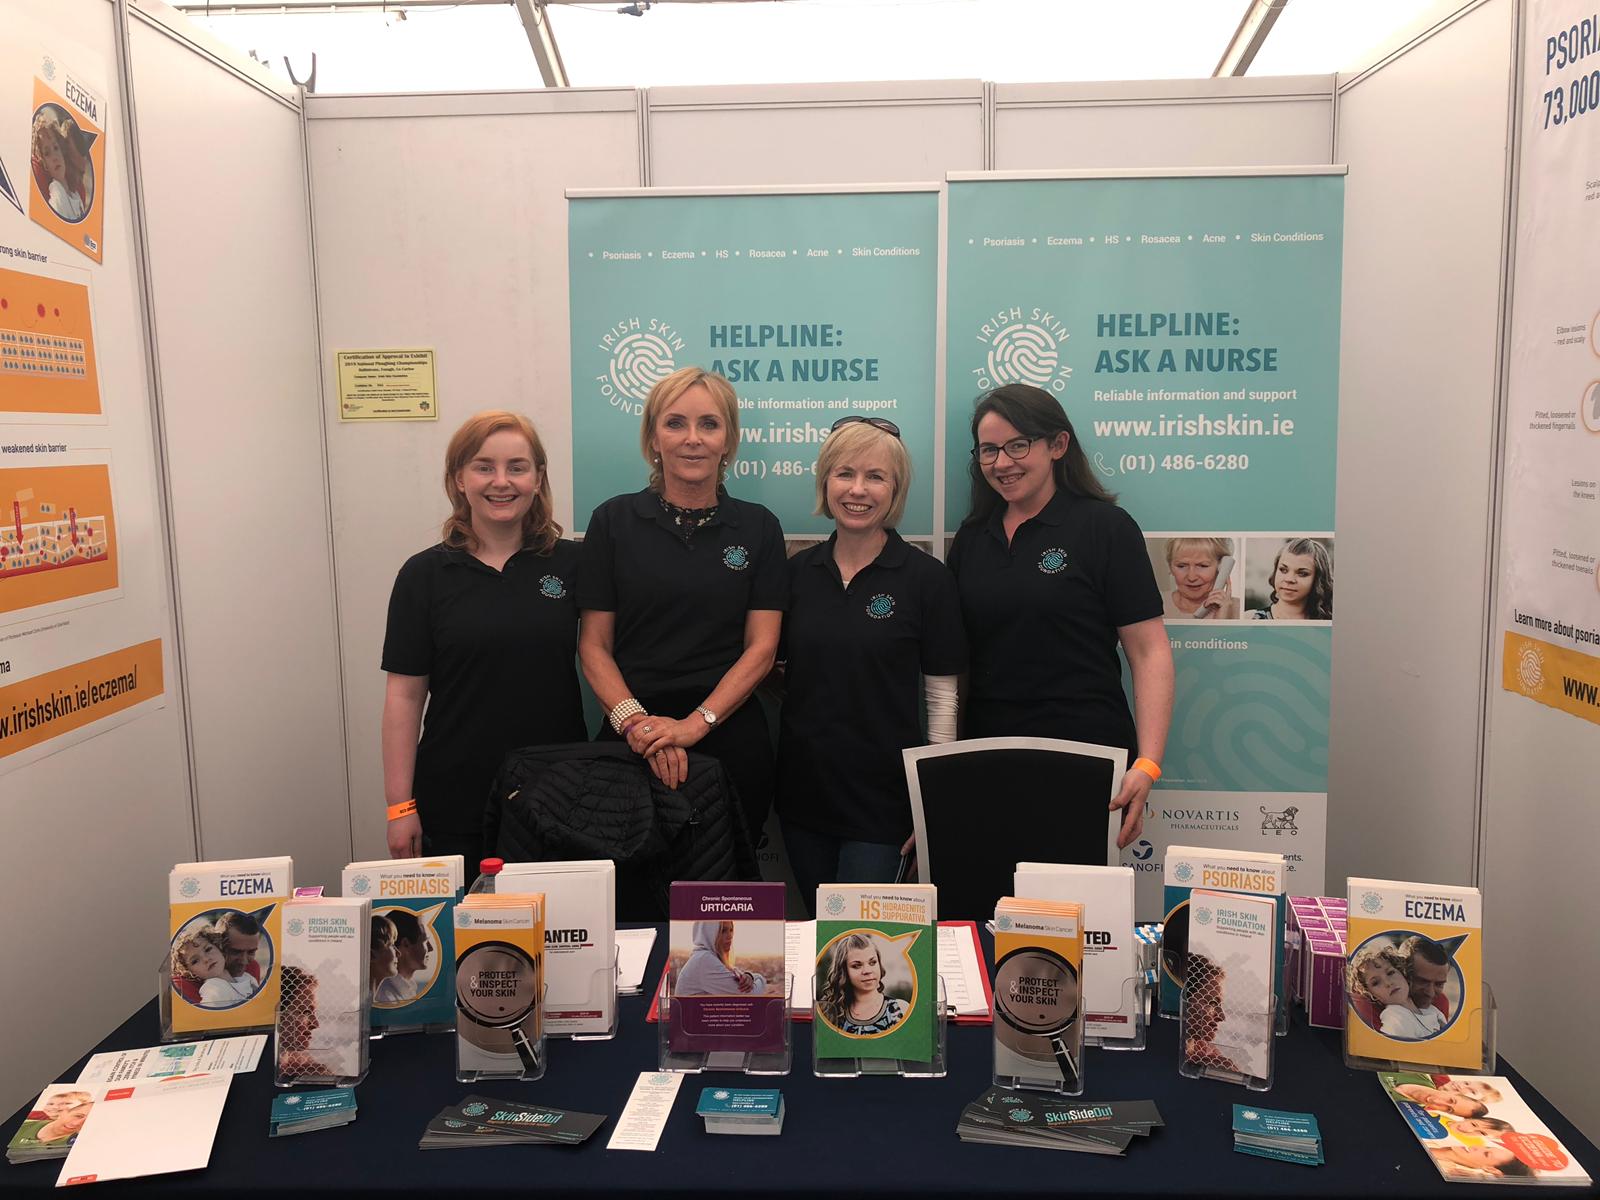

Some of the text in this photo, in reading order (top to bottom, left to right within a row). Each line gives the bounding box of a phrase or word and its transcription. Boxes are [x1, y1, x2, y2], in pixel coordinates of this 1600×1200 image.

[65, 81, 98, 122] ECZEMA
[1544, 70, 1600, 129] 73,000
[983, 231, 1324, 248] Psoriasis Eczema HS Rosacea Acne Skin Conditions
[14, 248, 27, 259] skin
[28, 249, 48, 263] barrier
[602, 246, 920, 260] Psoriasis Eczema HS Rosacea Acne Skin Conditions
[976, 306, 1070, 343] IRISH SKIN
[1097, 311, 1240, 338] HELPLINE:
[598, 316, 686, 352] IRISH SKIN
[710, 324, 843, 348] HELPLINE:
[1094, 347, 1278, 374] ASK A NURSE
[711, 358, 879, 383] ASK A NURSE
[596, 373, 645, 416] FOUND
[1094, 388, 1297, 405] Reliable information and support
[757, 398, 826, 409] information
[828, 398, 849, 409] and
[852, 398, 897, 411] support
[1094, 413, 1294, 438] www.irishskin.ie
[1, 443, 67, 454] weakened skin barrier
[733, 460, 818, 479] (01) 486-6
[1119, 453, 1249, 475] (01) 486-6280
[1514, 608, 1534, 627] Learn
[1534, 618, 1552, 632] more
[1553, 620, 1574, 639] about
[1170, 638, 1249, 650] in conditions
[1162, 808, 1240, 822] NOVARTIS
[1170, 823, 1240, 831] PHARMACEUTICALS
[220, 877, 274, 896] ECZEMA
[380, 879, 450, 896] PSORIASIS
[1202, 870, 1276, 892] PSORIASIS
[700, 903, 754, 912] URTICARIA
[860, 900, 881, 920] HS
[882, 902, 926, 914] HIDRADENITIS
[1405, 900, 1466, 922] ECZEMA
[330, 918, 347, 926] SKIN
[882, 911, 926, 923] SUPPURATIVA
[1216, 909, 1258, 922] IRISH SKIN
[308, 926, 355, 934] FOUNDATION
[1015, 922, 1044, 930] Melanoma
[1216, 918, 1266, 931] FOUNDATION
[544, 928, 588, 944] ANTED
[1084, 930, 1112, 945] TED
[470, 975, 478, 989] &
[479, 971, 516, 979] PROTECT
[1019, 976, 1058, 987] PROTECT
[470, 989, 516, 997] YOUR SKIN
[1010, 980, 1019, 994] &
[1010, 993, 1057, 1006] YOUR SKIN
[490, 1110, 563, 1124] SkinSideOut
[1044, 1106, 1113, 1123] SkinSideOut
